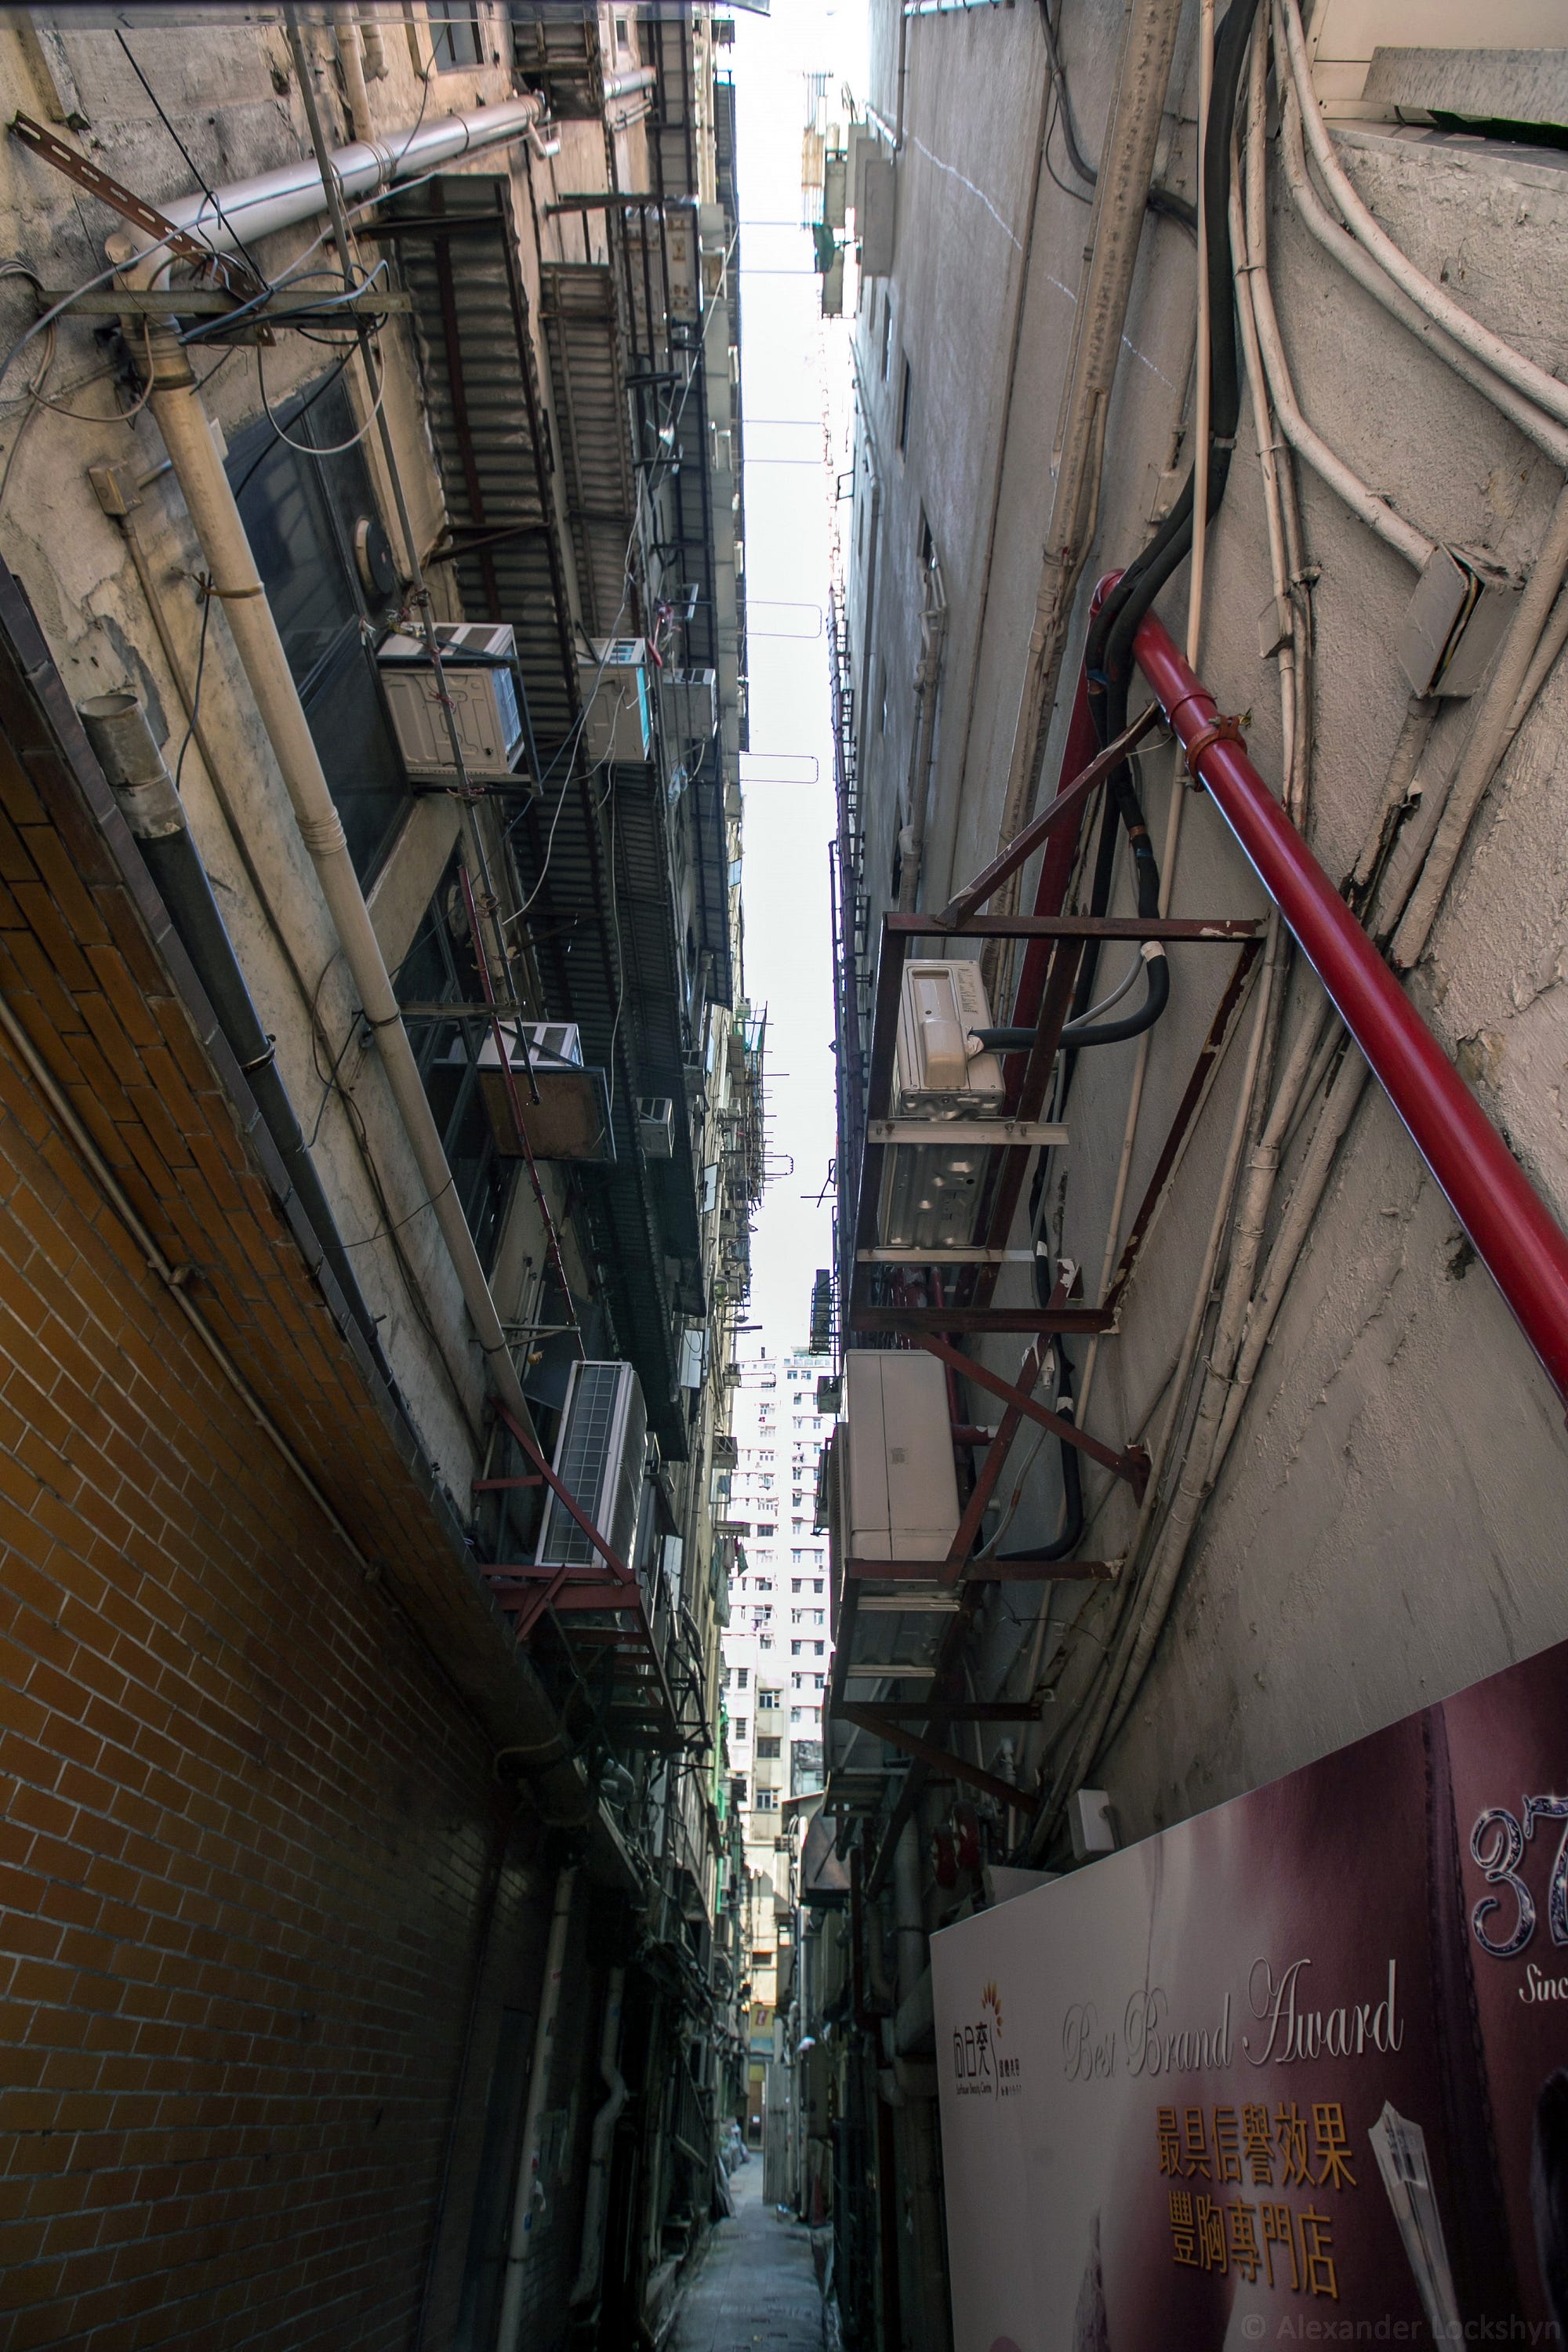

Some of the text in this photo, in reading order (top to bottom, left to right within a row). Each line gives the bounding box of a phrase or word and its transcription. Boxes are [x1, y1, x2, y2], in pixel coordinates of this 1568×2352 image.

[1062, 1956, 1404, 2082] Best Brand Award
[1156, 2101, 1358, 2190] 最具信譽效果
[1168, 2190, 1339, 2300] 豐胸專門店
